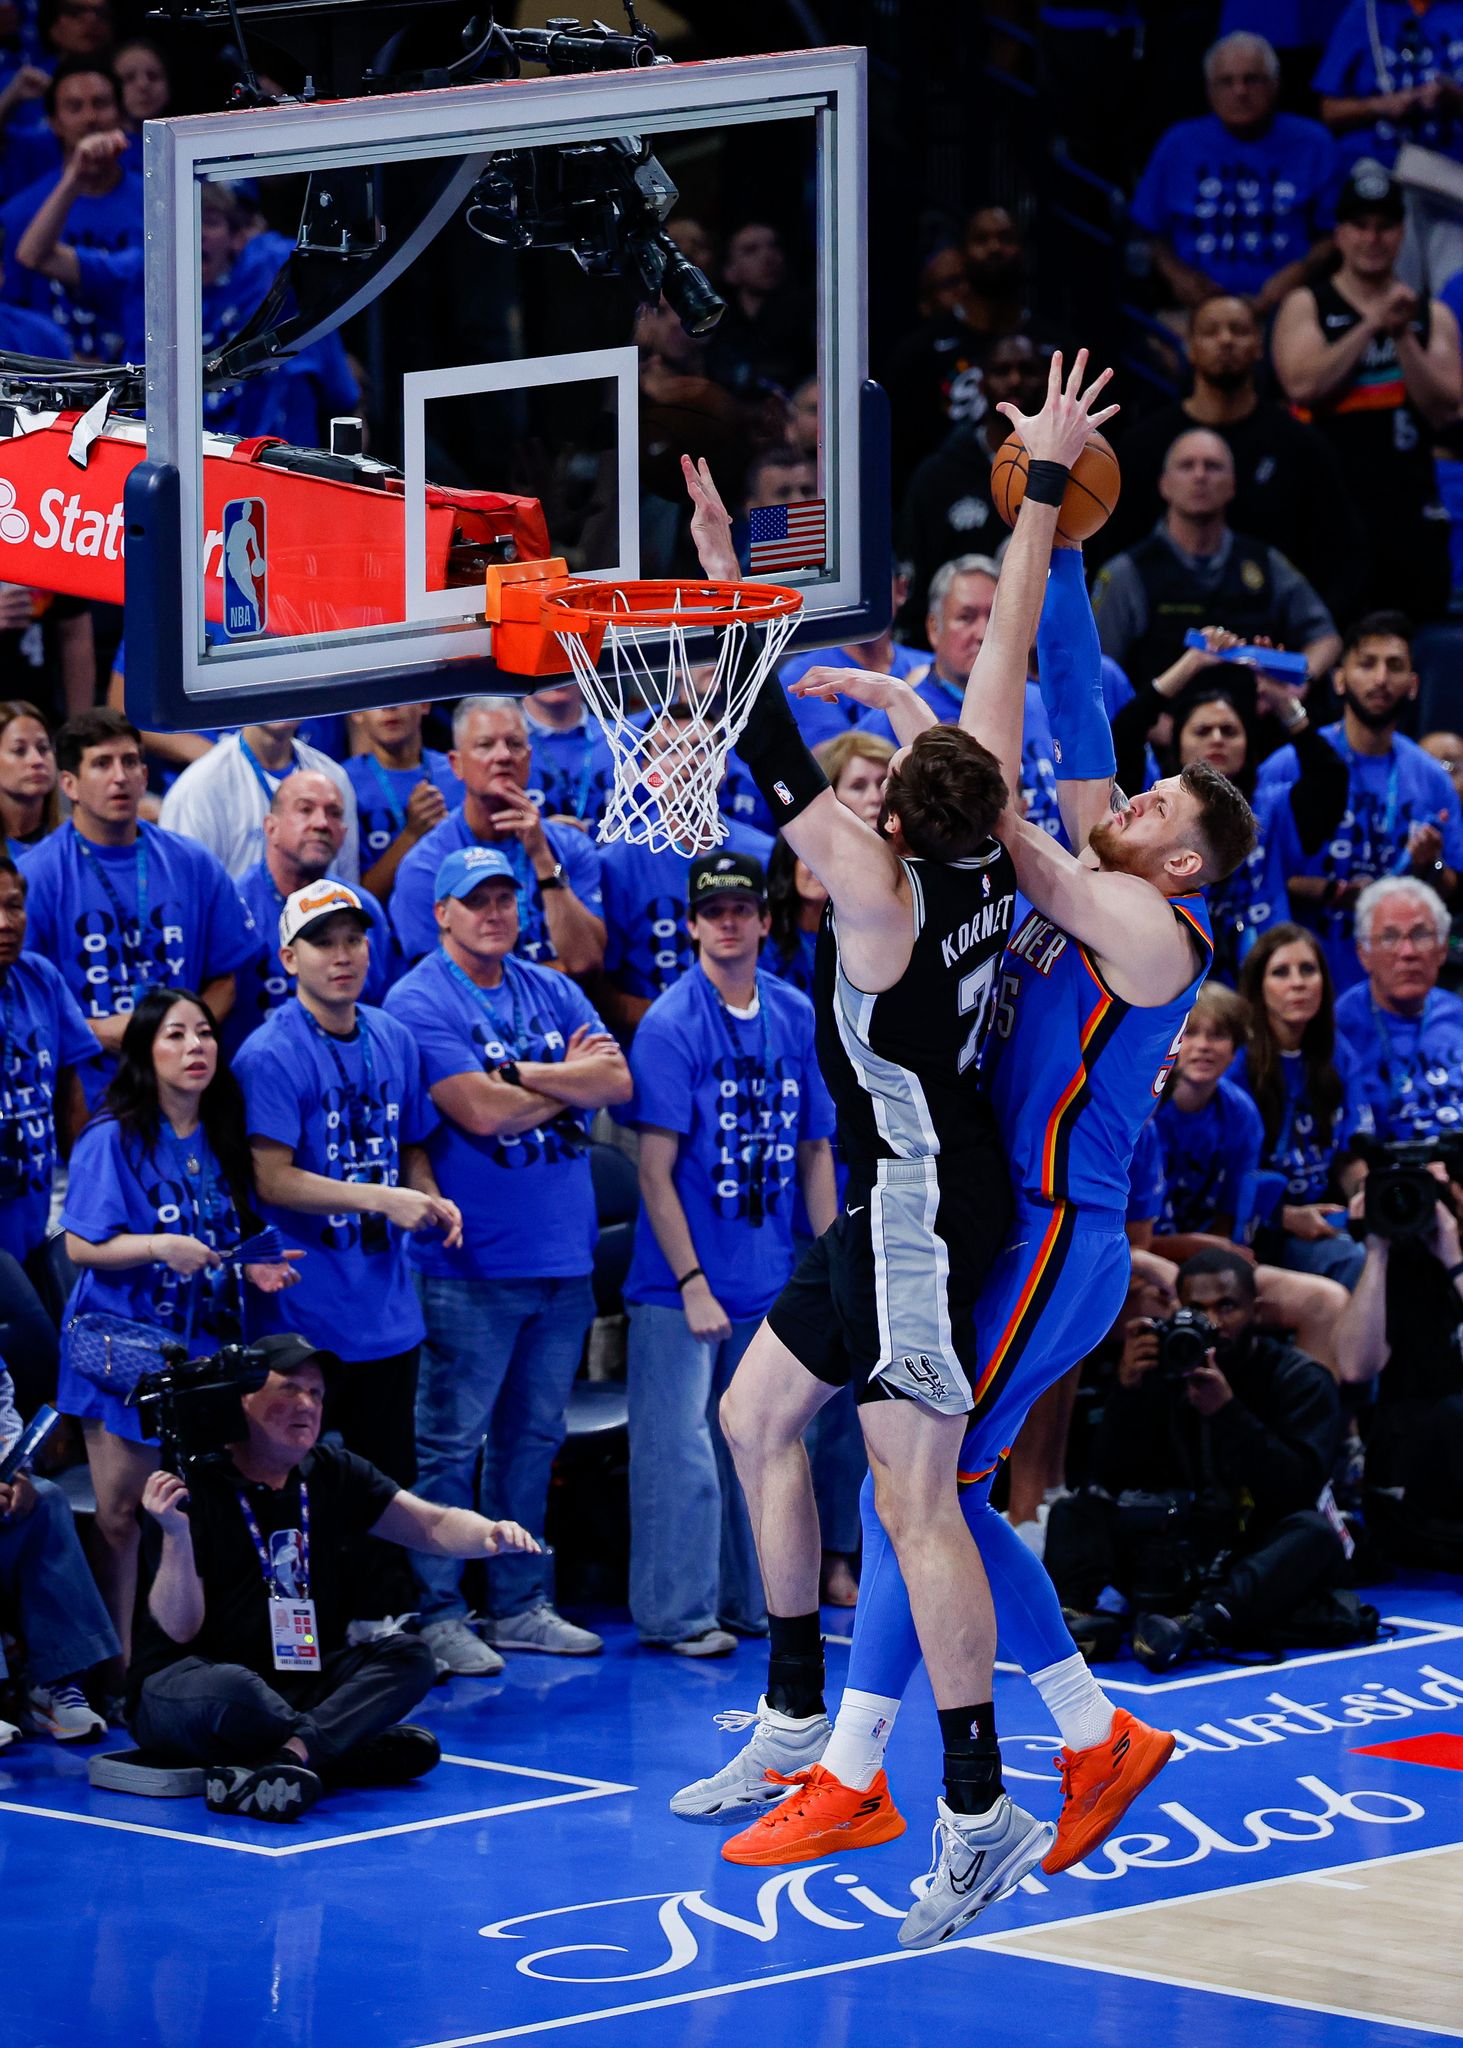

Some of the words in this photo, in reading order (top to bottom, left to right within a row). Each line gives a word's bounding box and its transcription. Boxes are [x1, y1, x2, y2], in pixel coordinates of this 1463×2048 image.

[33, 488, 125, 560] Stat
[230, 605, 251, 629] NBA
[83, 925, 184, 954] OUR
[941, 895, 1014, 968] KORNET
[86, 957, 185, 985] CITY
[90, 996, 136, 1018] LO
[958, 952, 1000, 1075] 7
[484, 1030, 566, 1060] OR
[719, 1078, 800, 1099] OUR
[326, 1103, 400, 1129] OR
[718, 1110, 798, 1131] CTY
[478, 1774, 1426, 1983] Mielob
